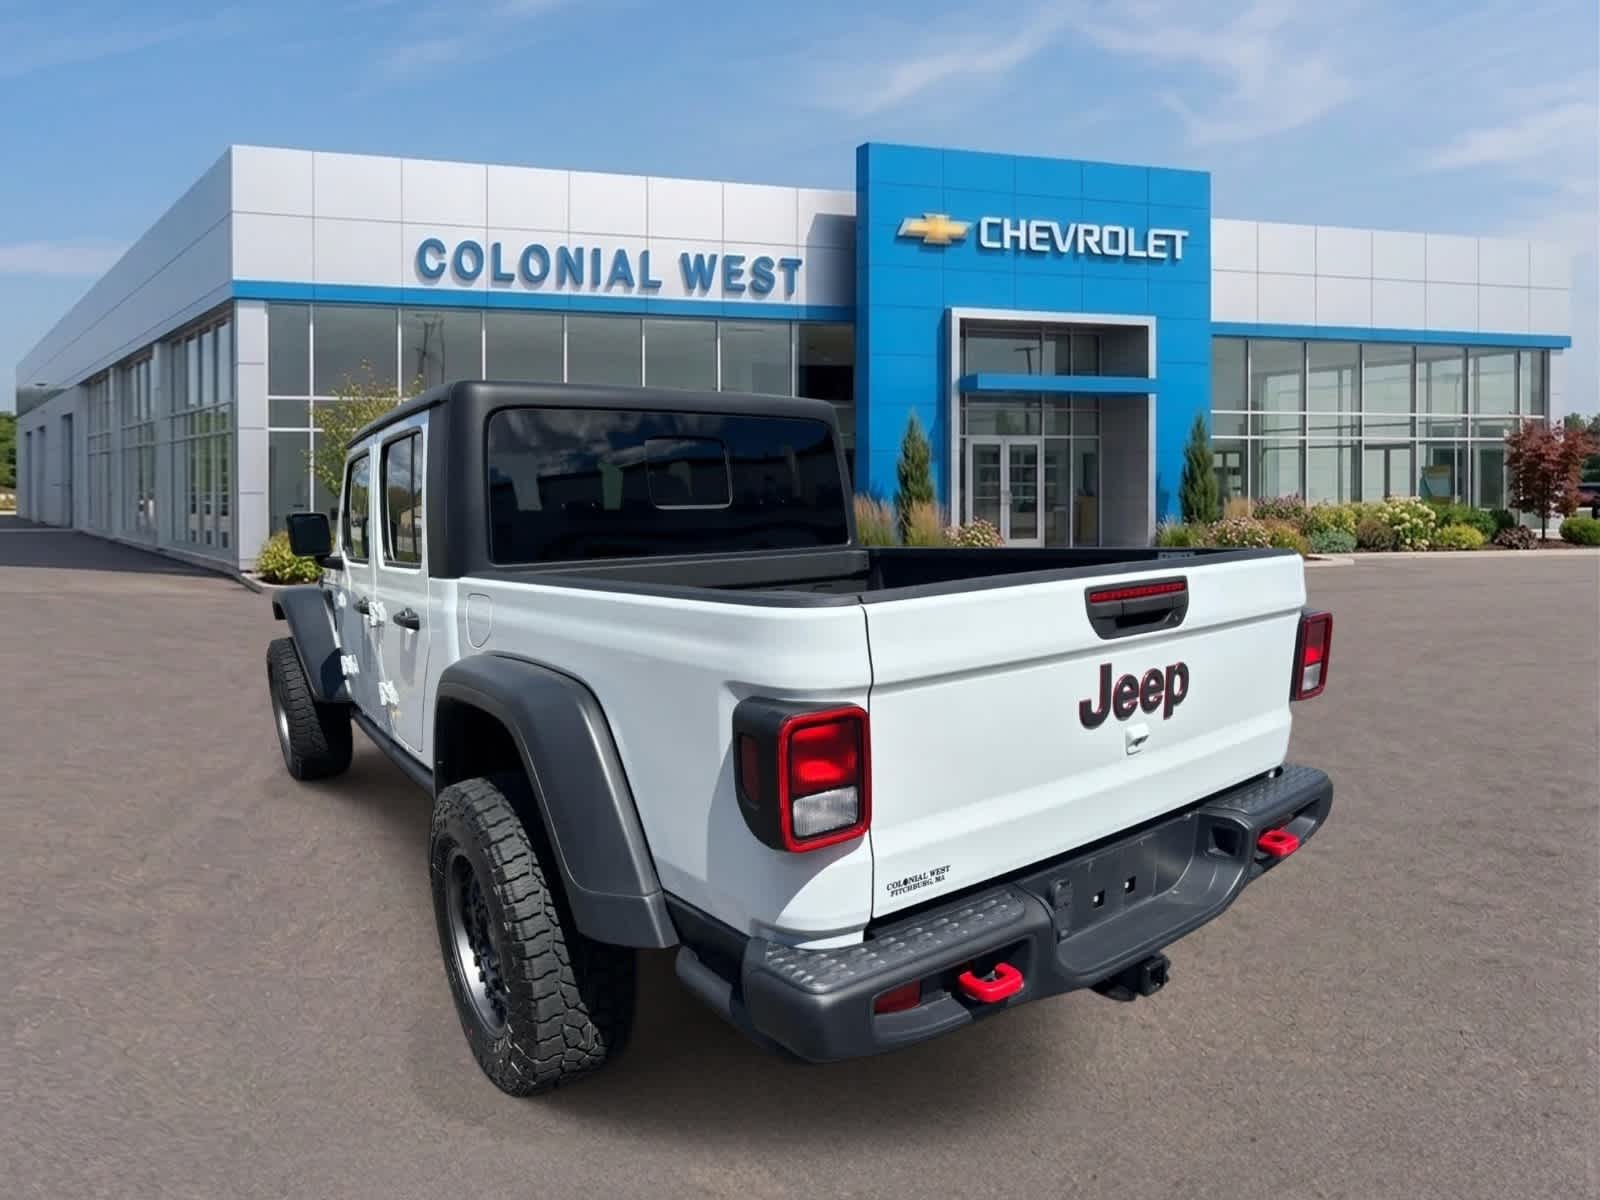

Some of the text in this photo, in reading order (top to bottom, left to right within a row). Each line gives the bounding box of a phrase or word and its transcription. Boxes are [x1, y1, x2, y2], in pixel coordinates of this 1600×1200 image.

[980, 216, 1189, 260] CHEVROLET
[416, 238, 803, 297] COLONIAL WEST
[1079, 662, 1190, 730] Jeep
[886, 865, 951, 891] COLONIAL WEST
[934, 875, 945, 883] MA
